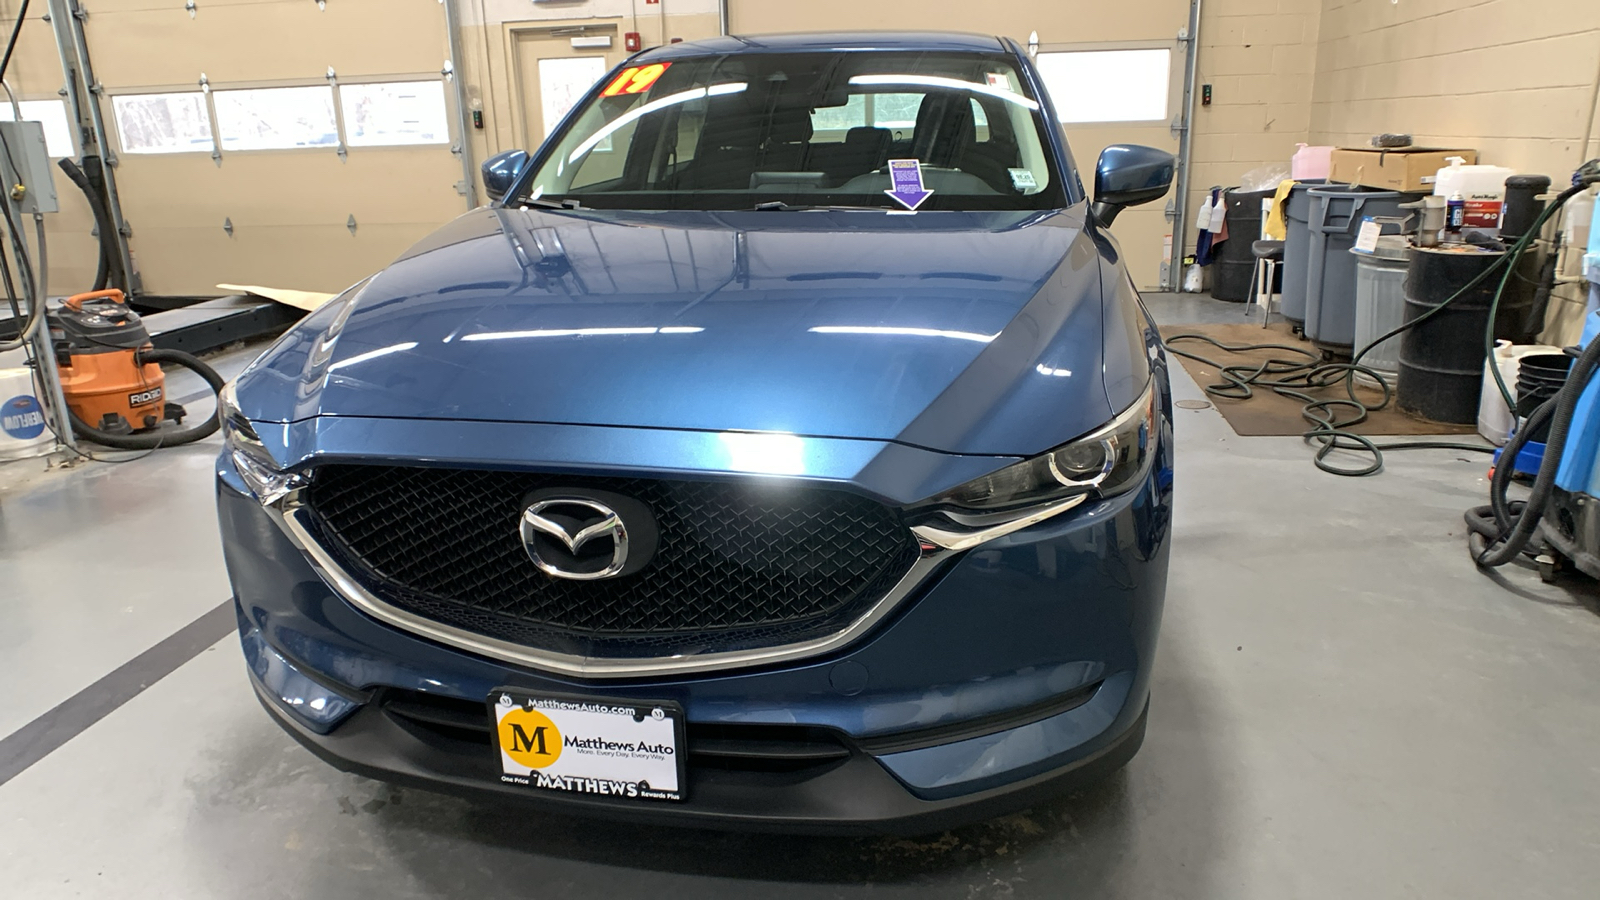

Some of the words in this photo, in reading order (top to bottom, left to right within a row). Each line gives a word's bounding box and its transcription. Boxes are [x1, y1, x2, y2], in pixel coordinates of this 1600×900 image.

[604, 64, 664, 95] 19
[527, 698, 636, 716] MatthewsAuto.com
[508, 723, 551, 756] M
[564, 735, 635, 752] Matthews
[636, 741, 674, 755] Auto
[596, 750, 614, 758] Every
[631, 752, 649, 760] Every
[514, 777, 529, 785] Price
[536, 775, 638, 798] MATTHEWS
[640, 791, 666, 799] Rewards
